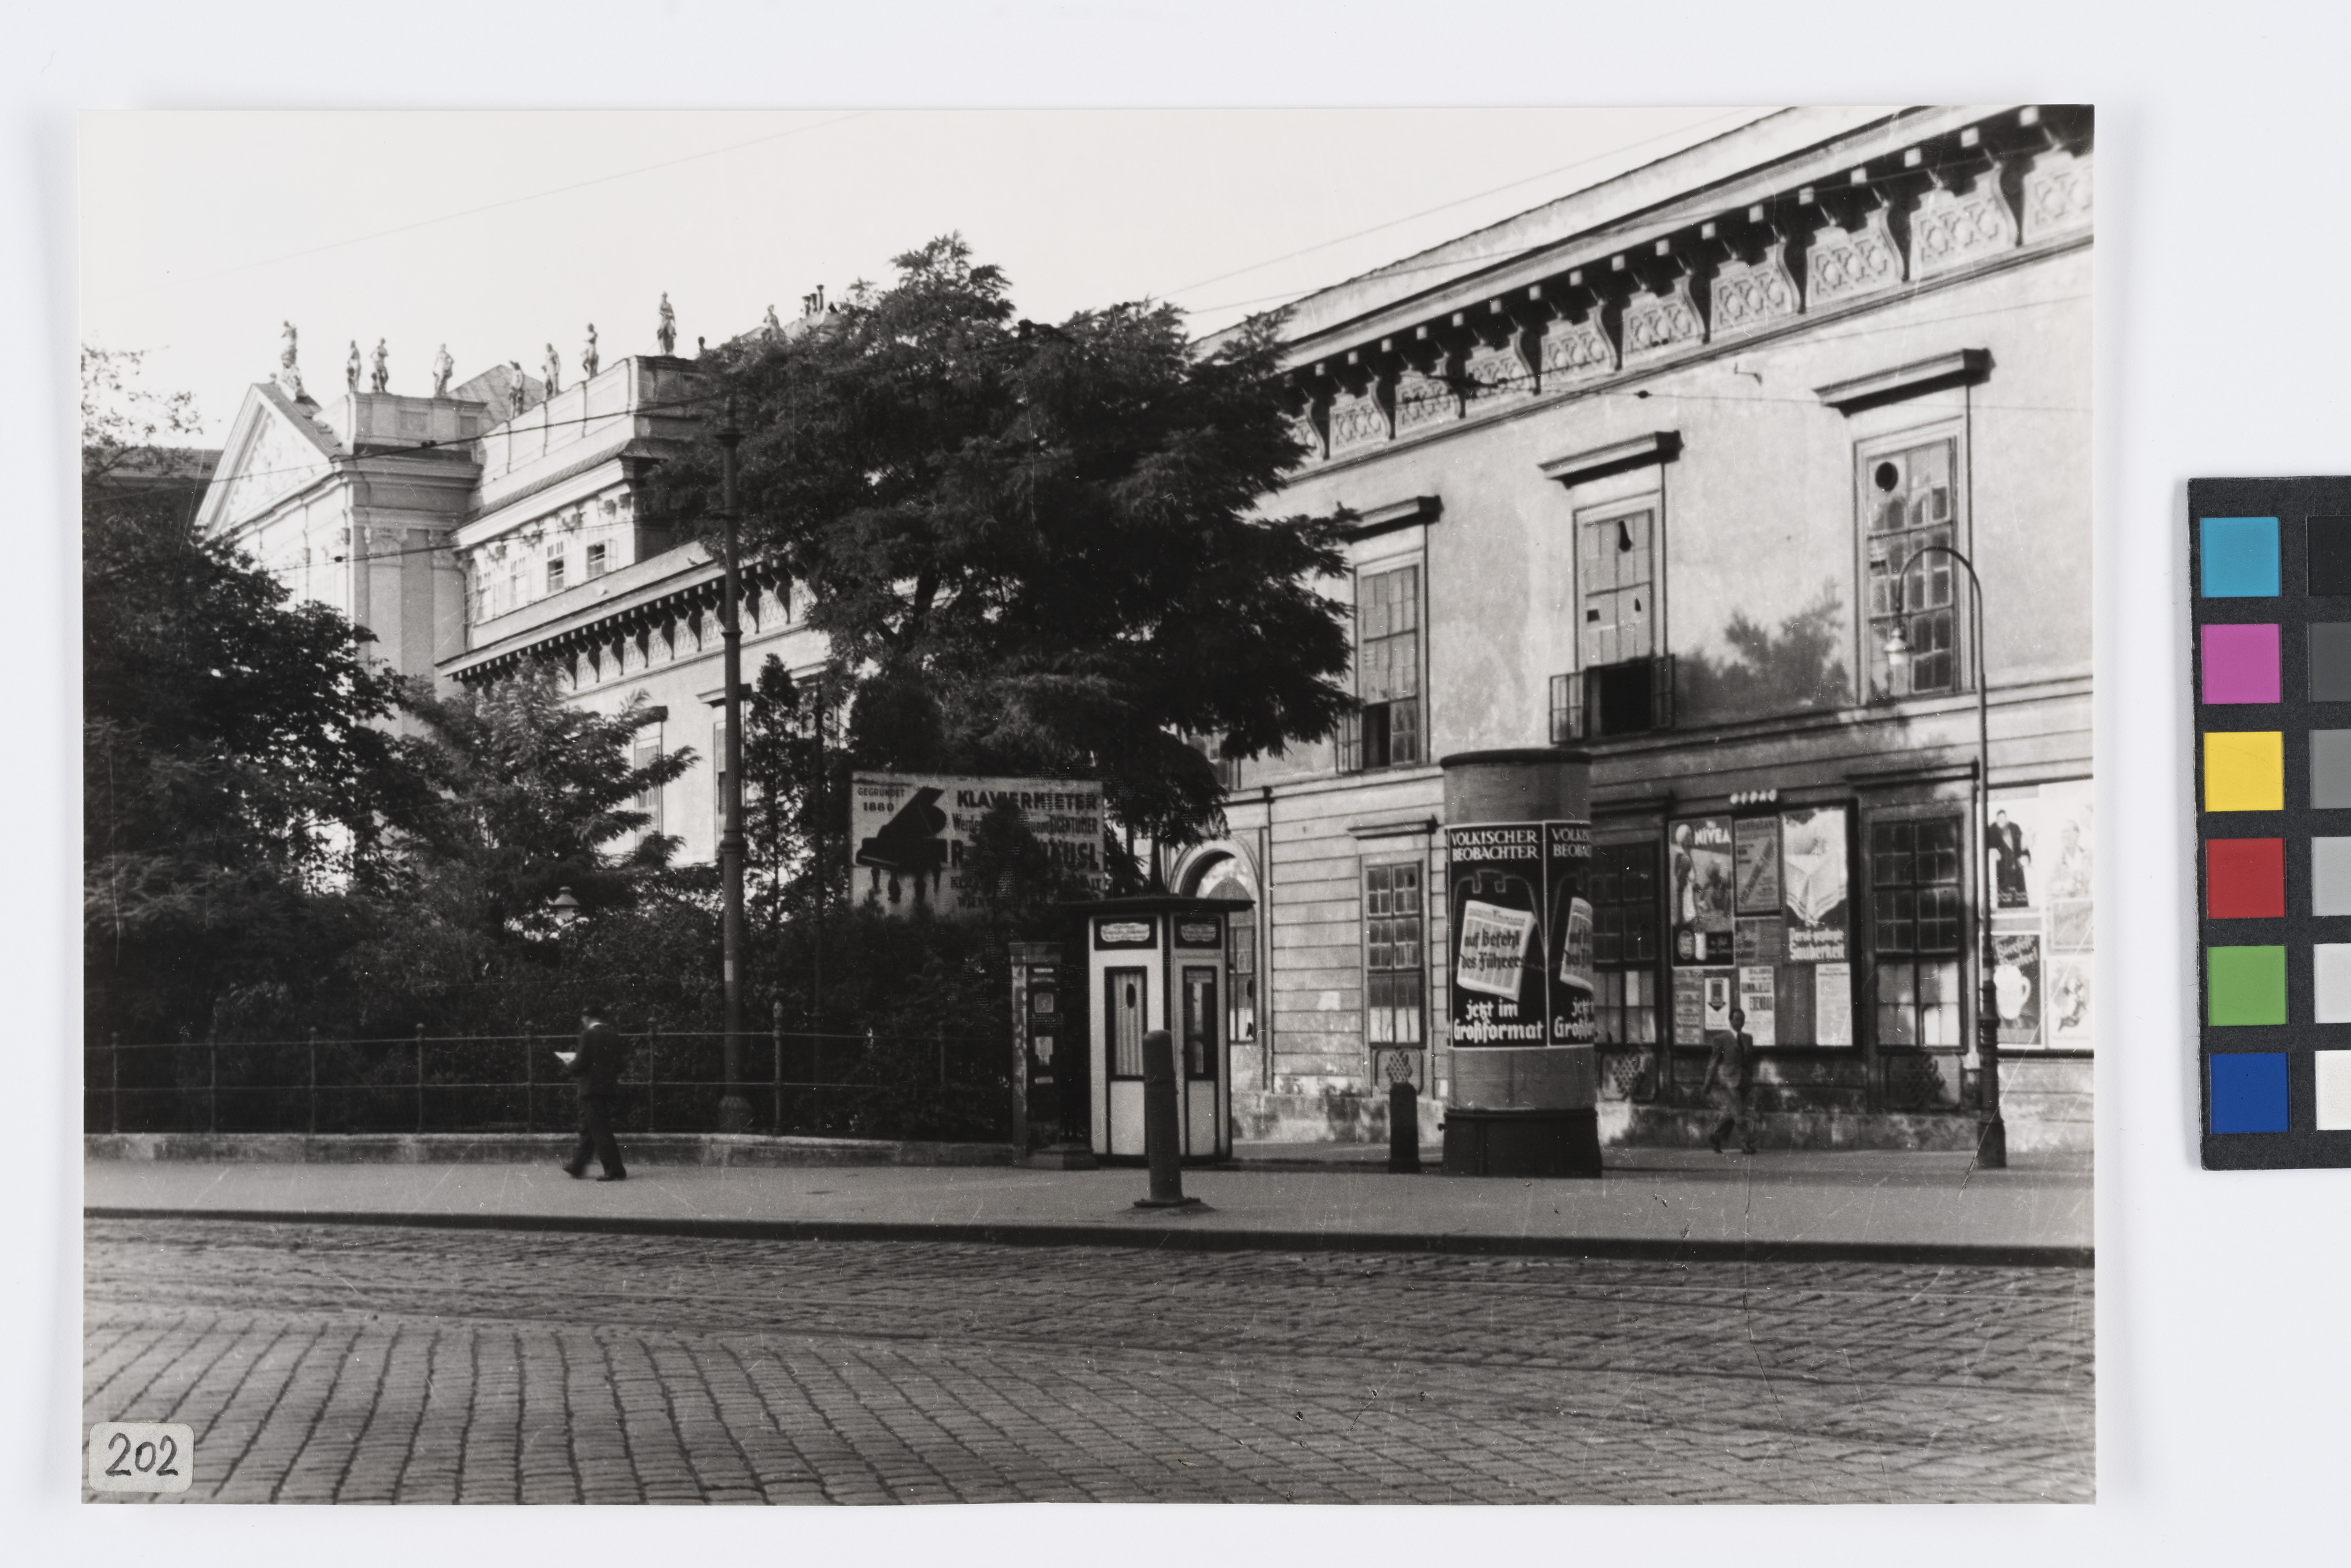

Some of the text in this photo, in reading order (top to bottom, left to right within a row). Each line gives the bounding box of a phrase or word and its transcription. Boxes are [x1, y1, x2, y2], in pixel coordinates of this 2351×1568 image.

[862, 802, 894, 812] 1880
[1694, 827, 1732, 845] NIVEA
[1452, 845, 1541, 862] BEOBACHTER
[1498, 998, 1519, 1018] im
[1454, 1018, 1544, 1044] Großformat
